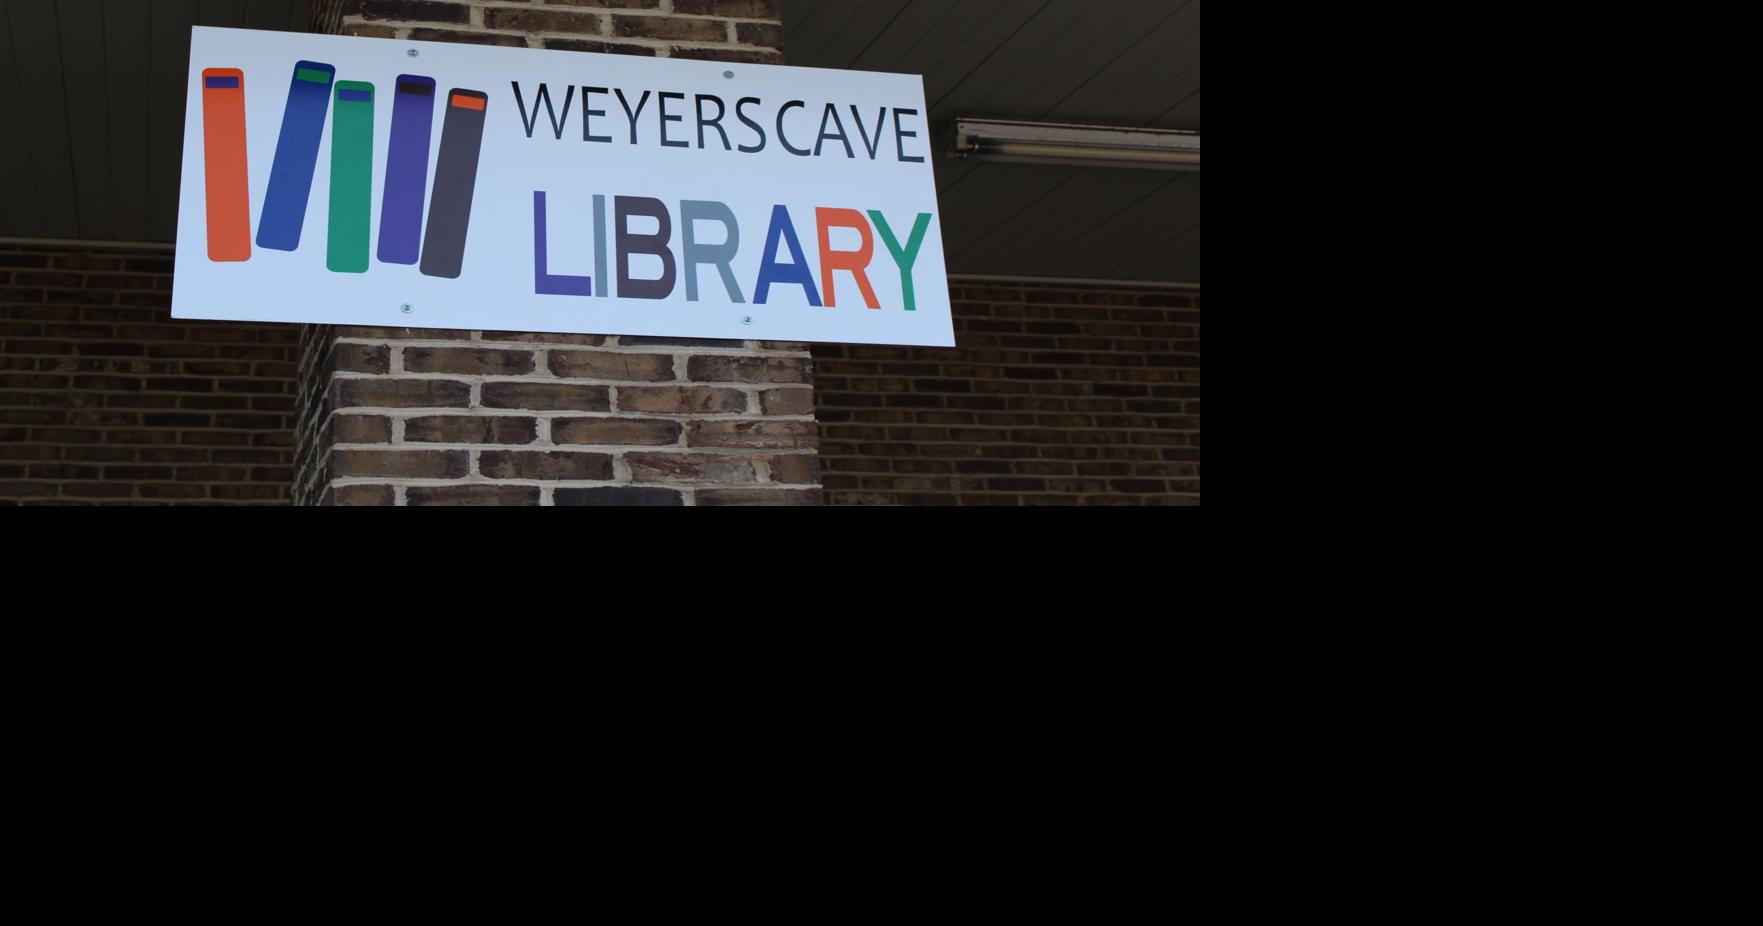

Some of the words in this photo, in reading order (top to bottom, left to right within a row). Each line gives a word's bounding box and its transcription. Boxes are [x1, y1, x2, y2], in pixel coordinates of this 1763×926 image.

[511, 80, 767, 154] WEYERS
[775, 99, 925, 163] CAVE
[533, 190, 932, 311] LIBRARY
